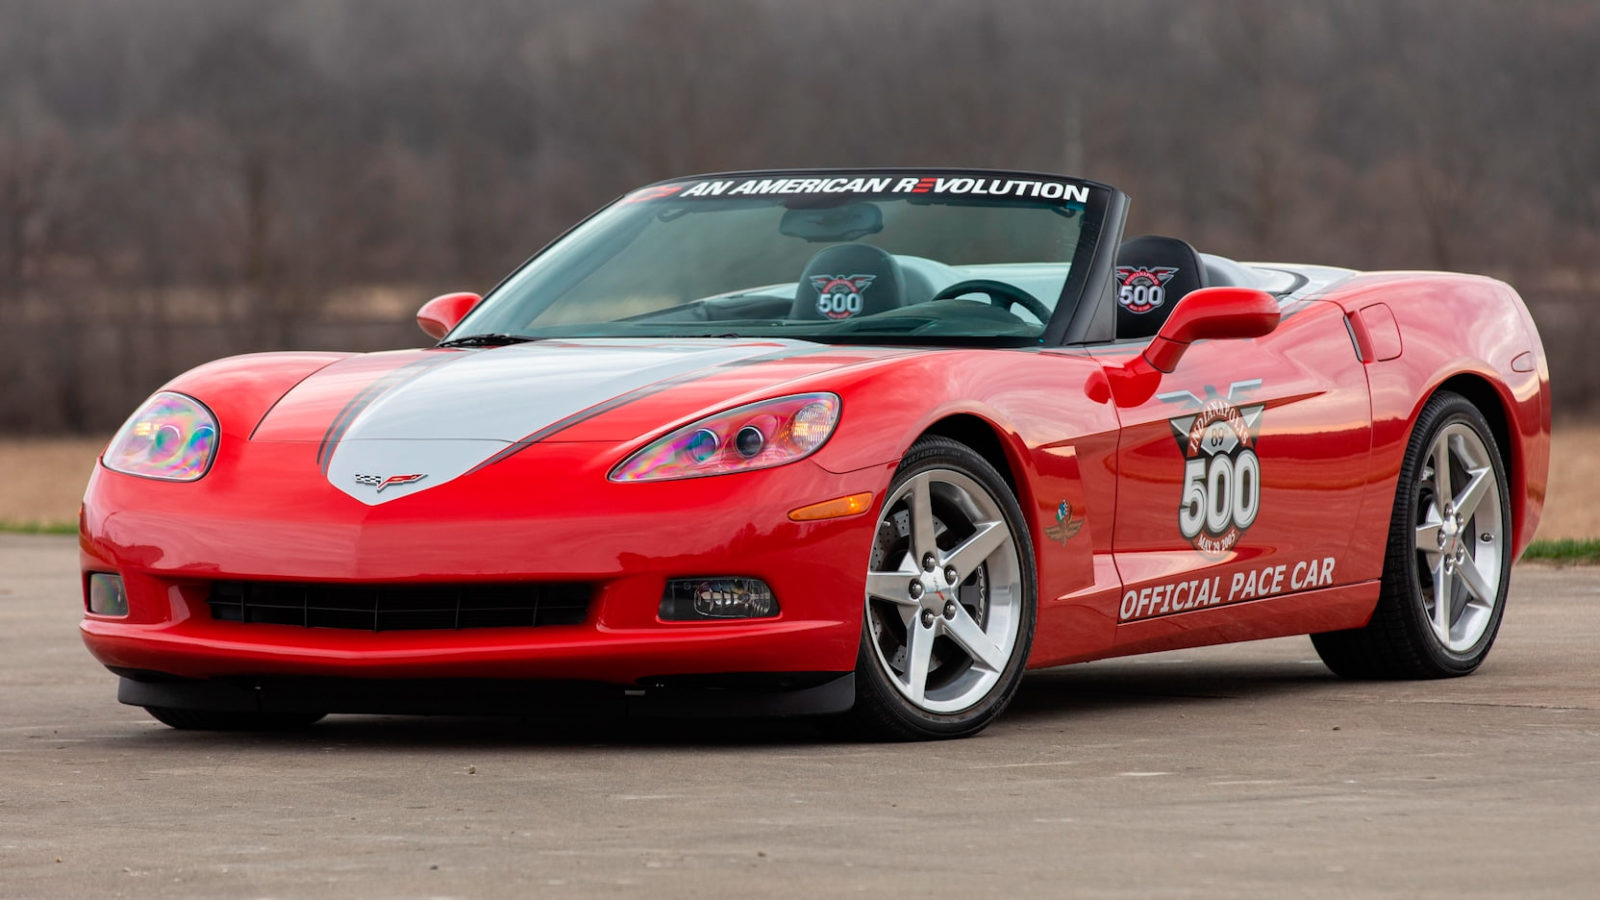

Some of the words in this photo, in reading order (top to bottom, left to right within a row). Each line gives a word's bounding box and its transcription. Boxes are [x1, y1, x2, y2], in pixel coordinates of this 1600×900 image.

[679, 181, 736, 197] AN
[727, 177, 892, 195] AMERICAN
[893, 177, 1089, 203] REVOLUTION
[818, 293, 861, 313] 500
[1119, 285, 1163, 306] 500
[1190, 400, 1248, 453] INDIANAPOLIS
[1179, 449, 1260, 538] 500
[1198, 533, 1213, 553] MAY
[1120, 576, 1221, 620] OFFICIAL
[1228, 564, 1287, 600] PACE
[1290, 557, 1336, 589] CAR
